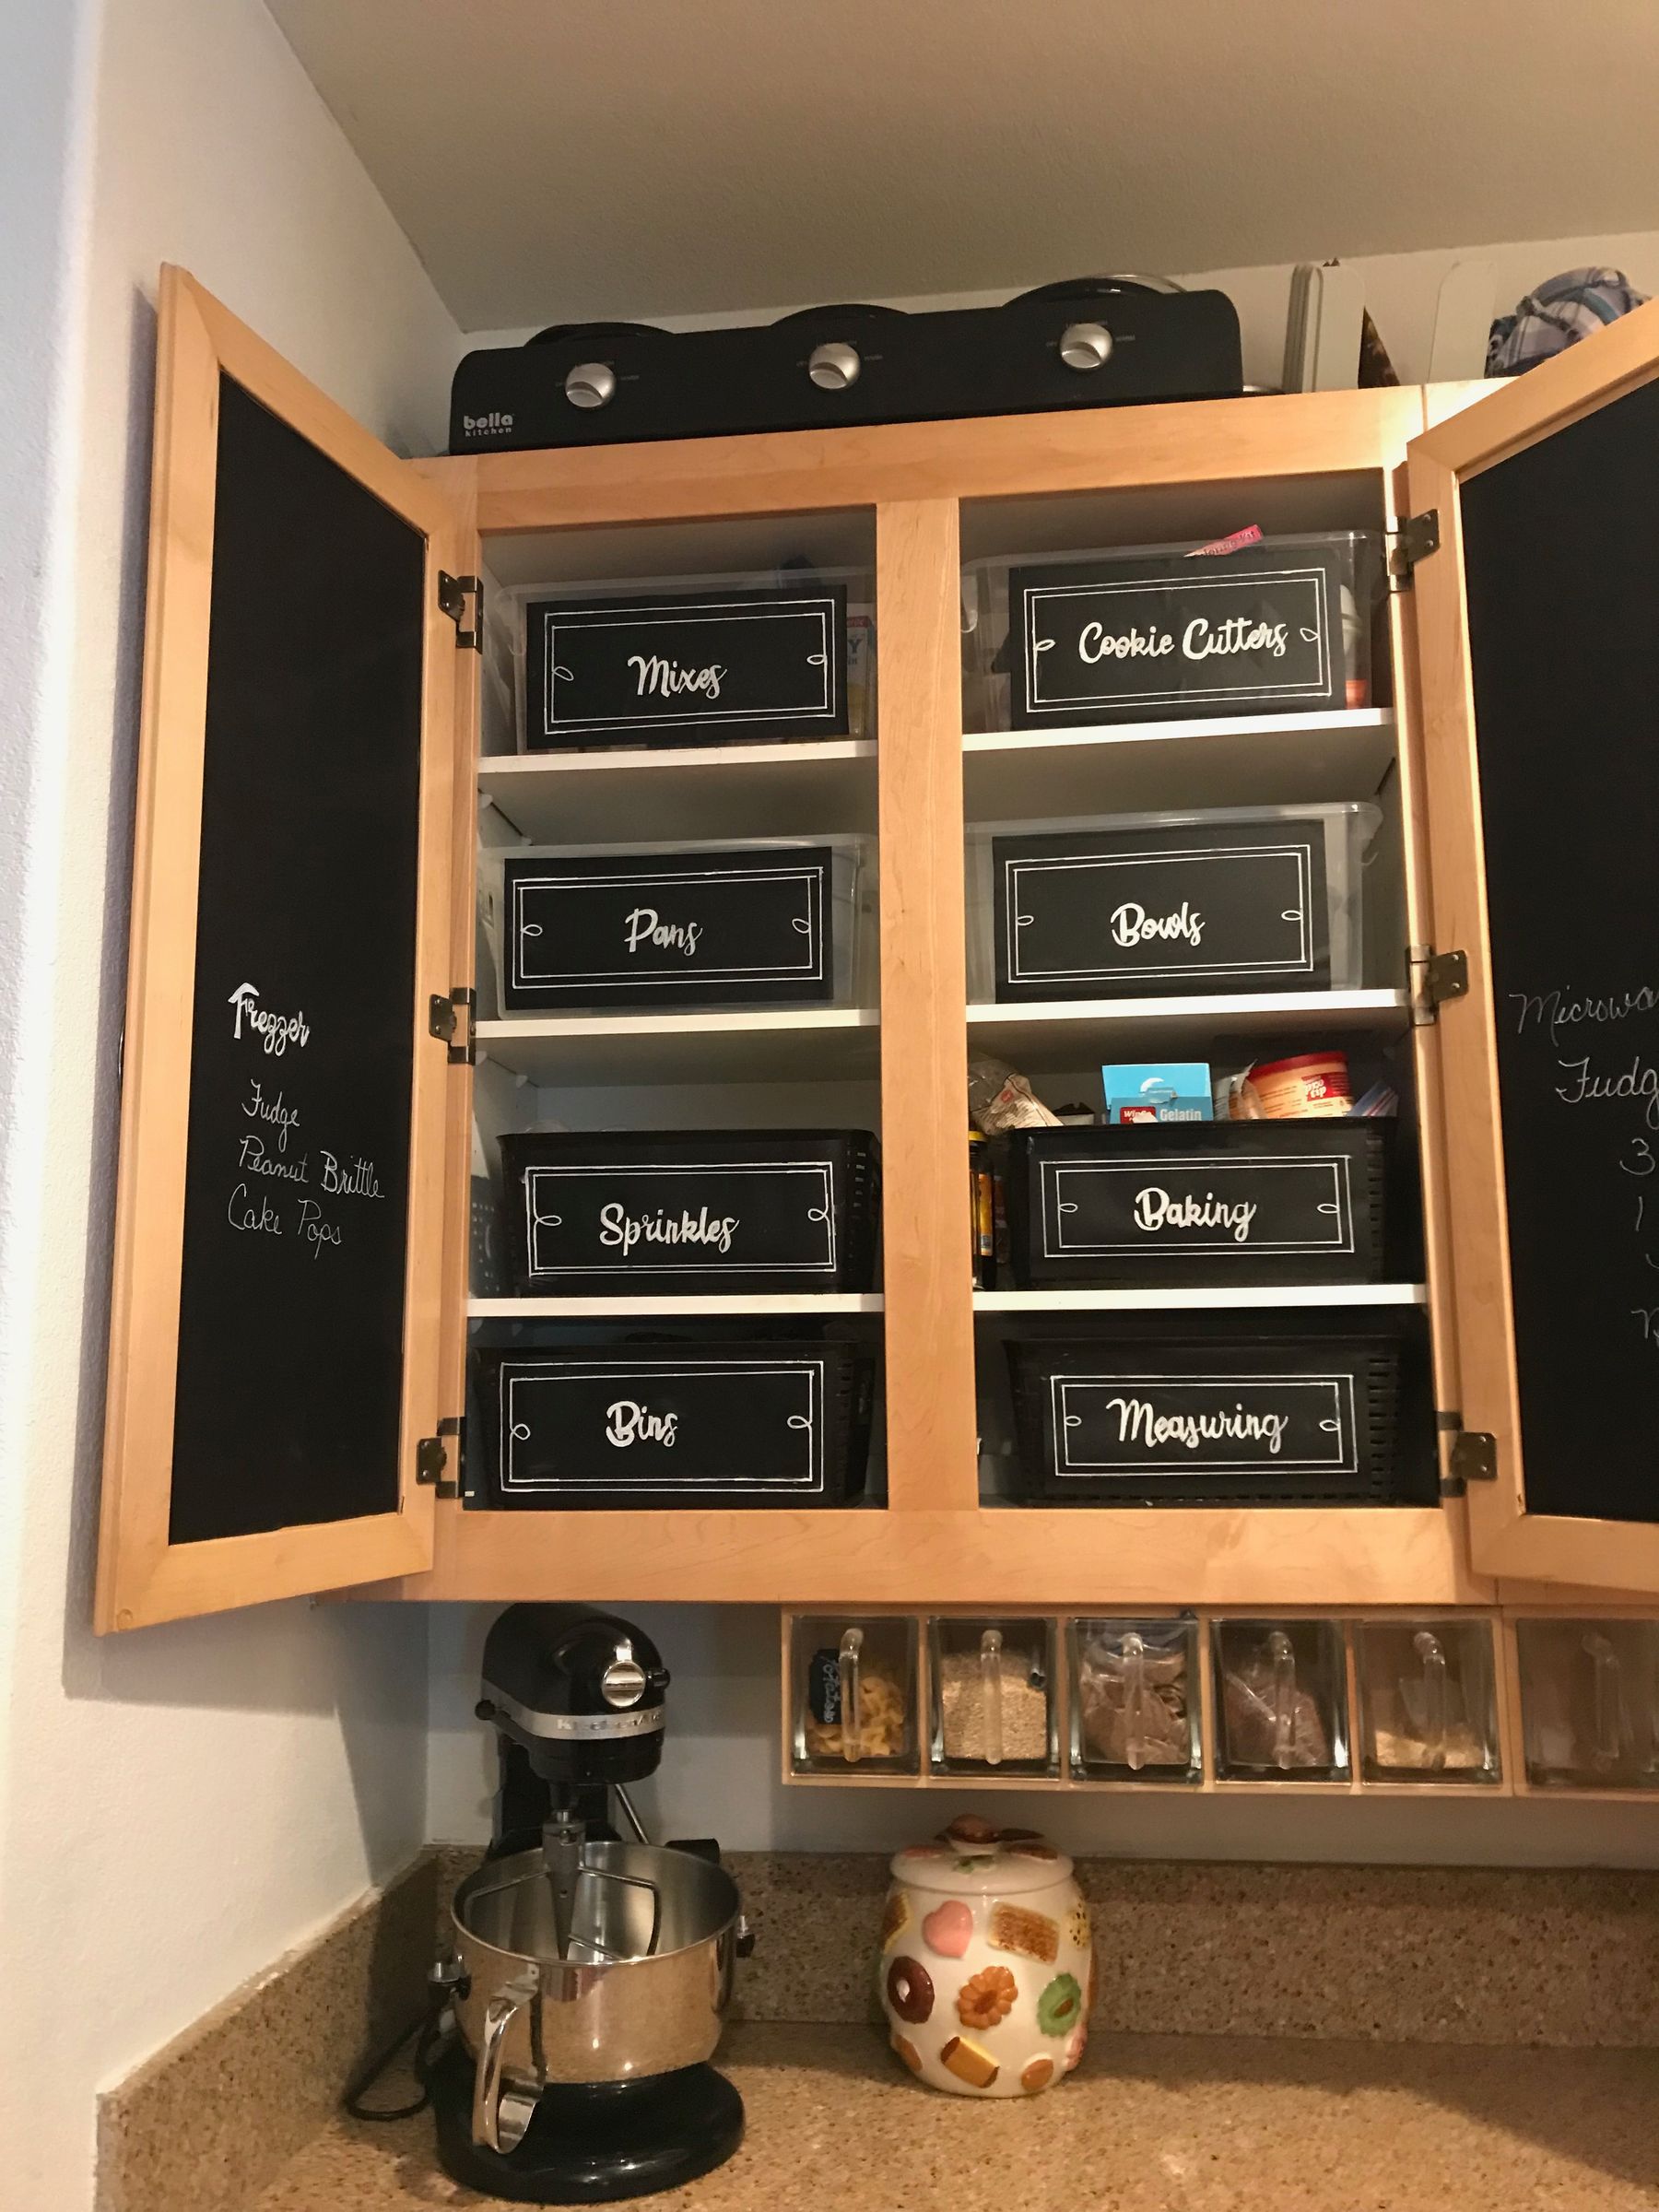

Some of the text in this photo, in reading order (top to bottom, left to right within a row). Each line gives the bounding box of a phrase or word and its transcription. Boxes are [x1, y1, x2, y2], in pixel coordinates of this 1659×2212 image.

[464, 412, 513, 429] bella
[465, 428, 512, 437] kitchen
[1078, 617, 1289, 665] Cookie Cutters
[627, 654, 728, 700] Mixes
[624, 908, 703, 956] Pans
[1110, 901, 1206, 947] Bowls
[1509, 984, 1659, 1047] Microwa
[241, 1078, 300, 1153] Fudge
[1159, 1108, 1203, 1122] Gelatin
[1555, 1056, 1659, 1131] Fudg
[240, 1135, 385, 1198] Peanut Brittle
[228, 1182, 342, 1261] Cake Pops
[599, 1202, 740, 1257] Sprinkles
[1134, 1187, 1257, 1242] Baking
[606, 1400, 678, 1448] Bins
[1106, 1397, 1289, 1454] Measuring
